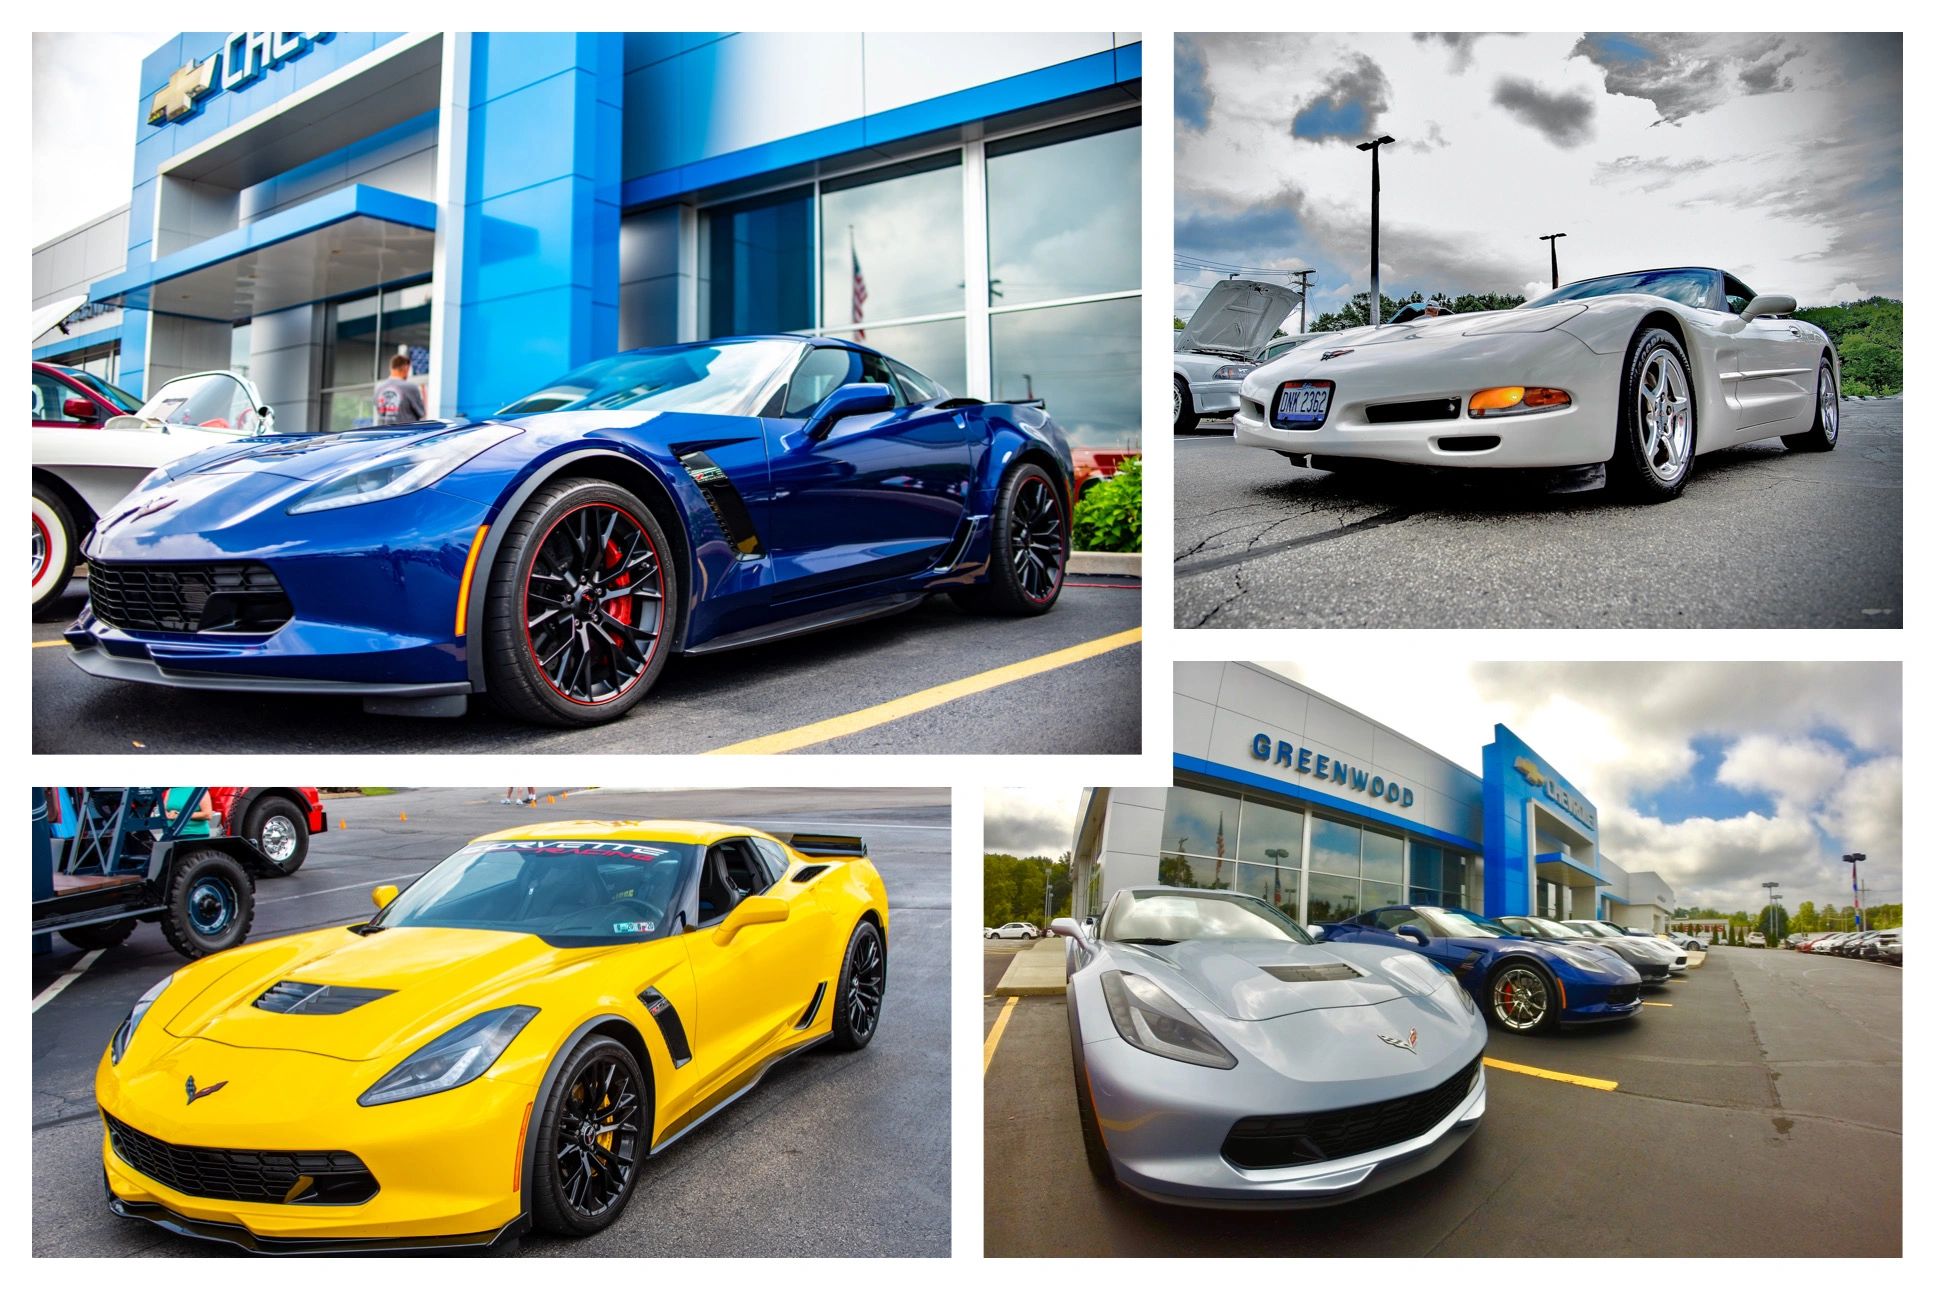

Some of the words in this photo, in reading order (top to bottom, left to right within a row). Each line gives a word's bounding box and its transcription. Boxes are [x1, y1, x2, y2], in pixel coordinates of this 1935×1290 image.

[1280, 391, 1301, 413] DNK
[1300, 390, 1327, 413] 2362
[1251, 733, 1415, 808] GREENWOOD
[463, 841, 669, 857] CORVETTE
[535, 847, 656, 862] RACING
